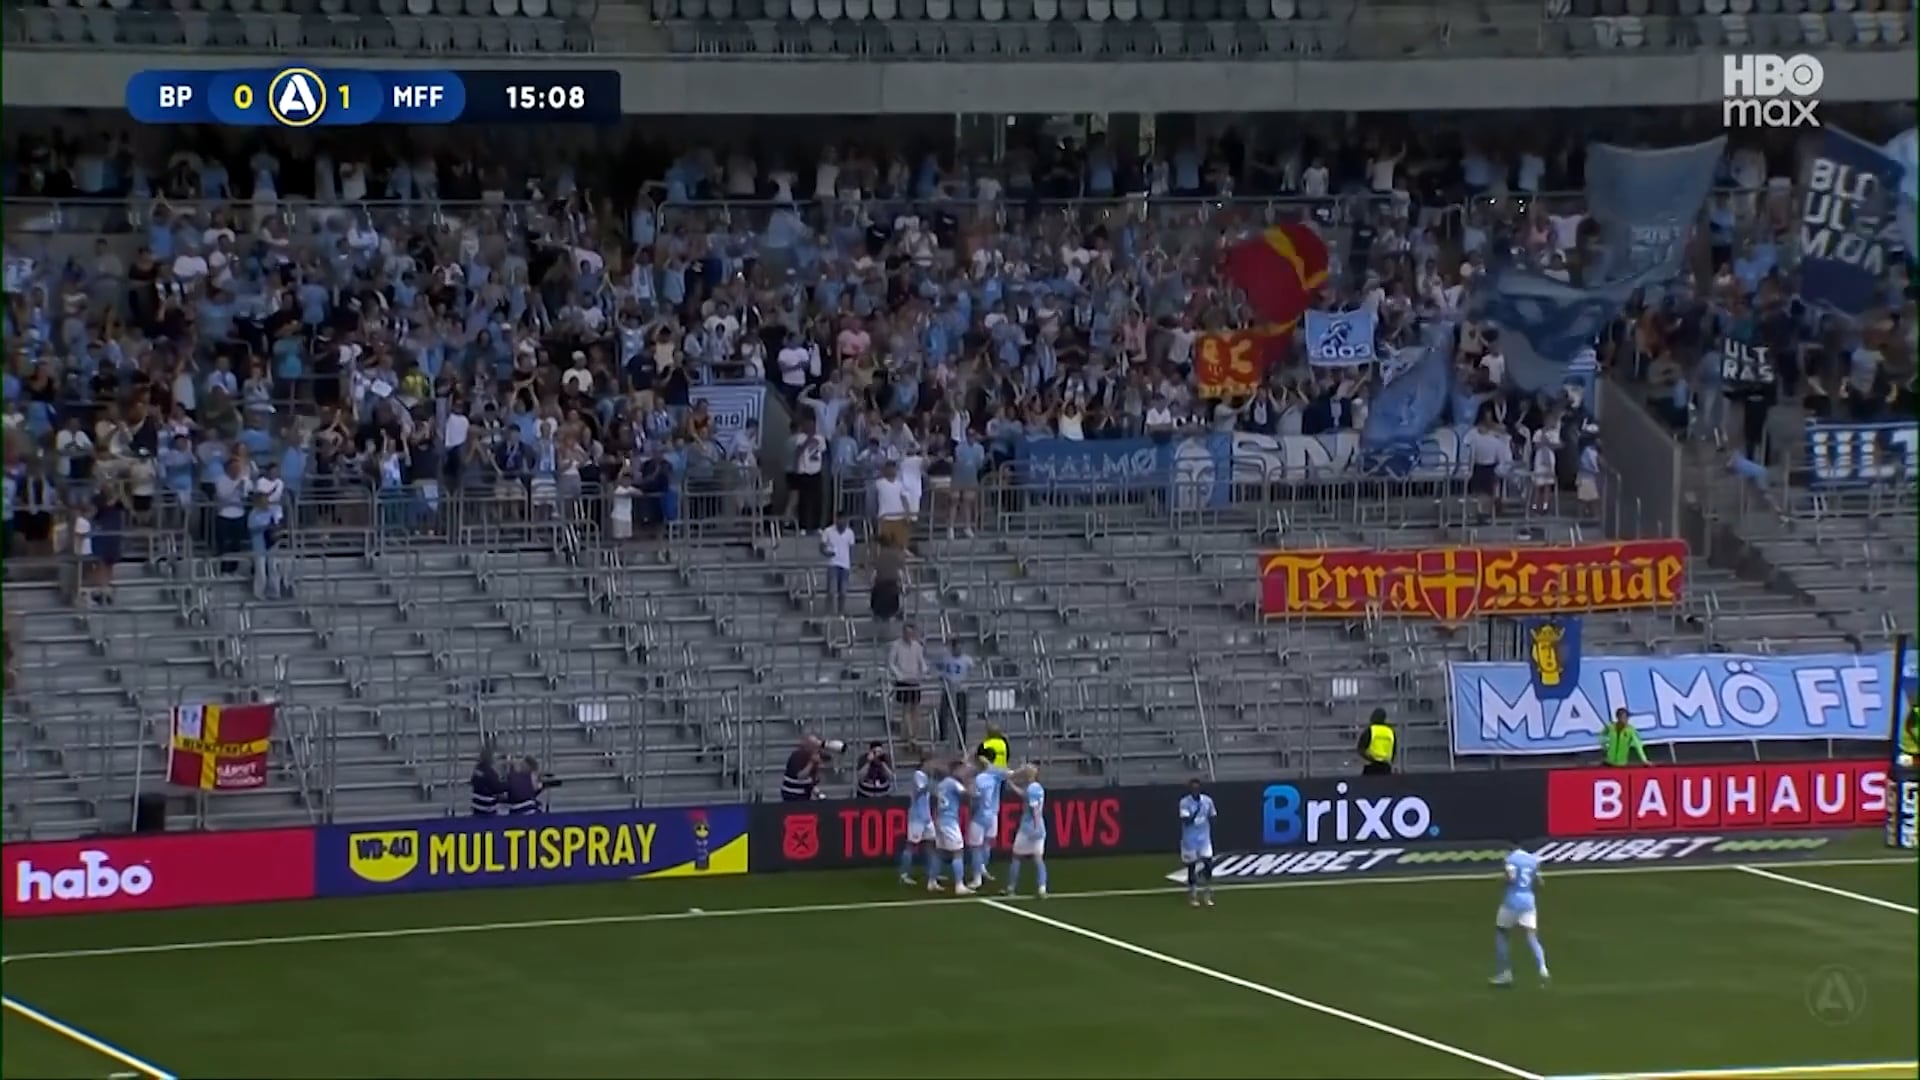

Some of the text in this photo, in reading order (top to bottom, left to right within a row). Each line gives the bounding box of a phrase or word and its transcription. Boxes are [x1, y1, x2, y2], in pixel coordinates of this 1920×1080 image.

[1724, 337, 1769, 363] ULT
[1722, 359, 1775, 382] RAS
[1479, 660, 1883, 741] MALMÖ FF
[1592, 772, 1887, 820] BAUHAUS
[1053, 797, 1120, 847] VVS
[356, 836, 411, 861] WD-40
[429, 823, 657, 875] MULTISPRAY
[1212, 848, 1405, 876] UNIBET
[1534, 837, 1722, 863] UNIBET
[16, 850, 152, 903] habo
